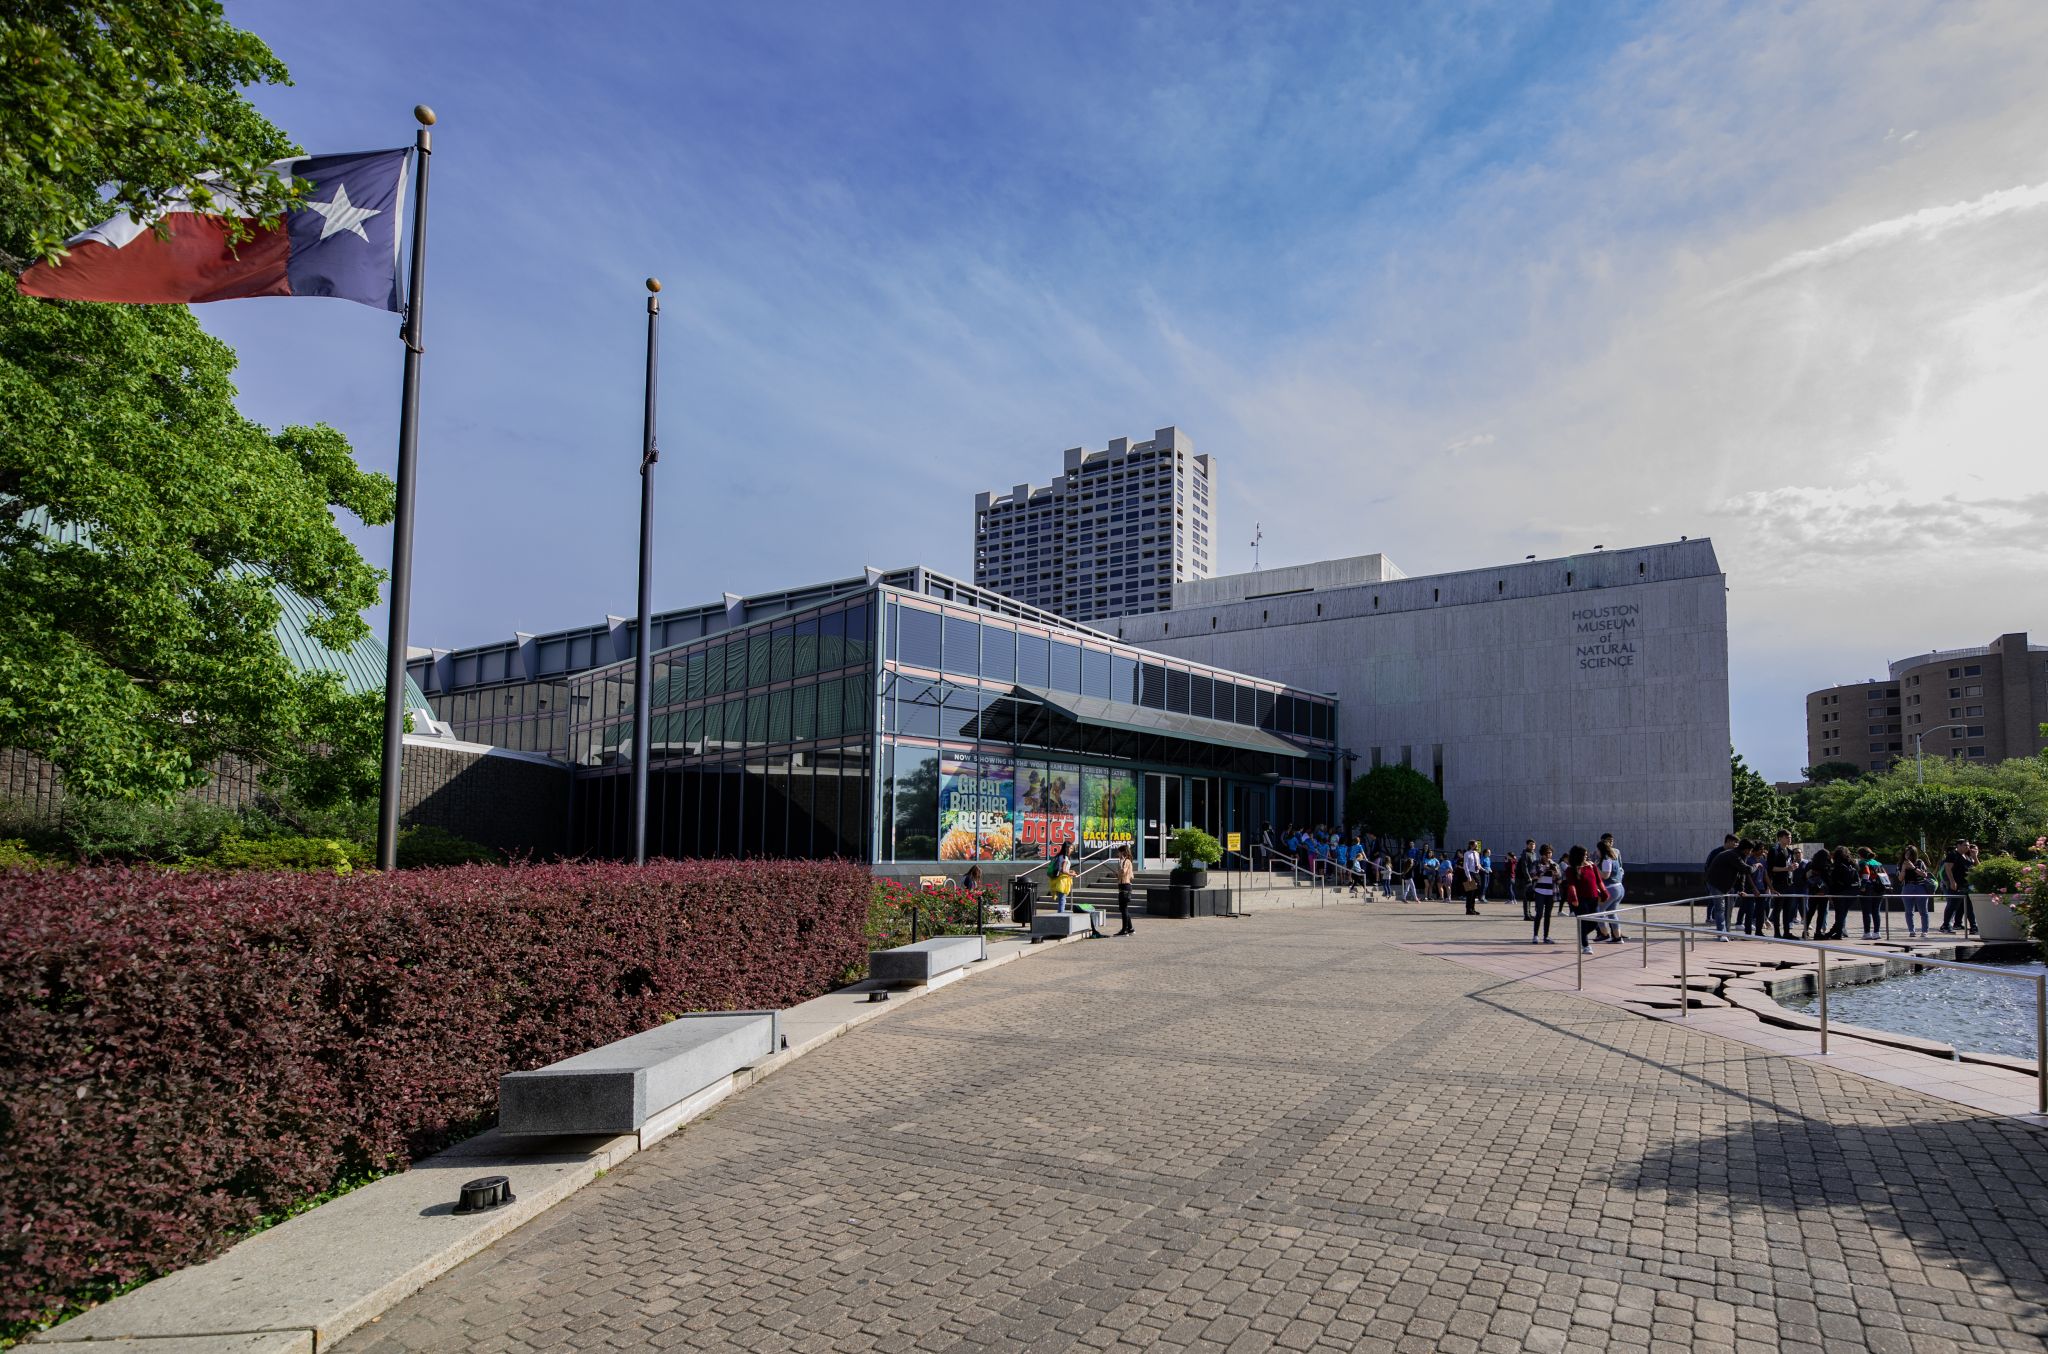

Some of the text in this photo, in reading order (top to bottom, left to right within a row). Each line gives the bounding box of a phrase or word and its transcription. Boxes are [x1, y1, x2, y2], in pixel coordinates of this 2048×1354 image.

[1572, 604, 1639, 620] HOUSTON
[1577, 618, 1635, 632] MUSEUM
[1600, 632, 1612, 643] of
[1577, 643, 1636, 656] NATURAL
[1580, 655, 1634, 669] SCIENCE
[973, 756, 1006, 765] SHOWING
[1021, 820, 1076, 845] DOGS
[1037, 844, 1062, 857] 3D
